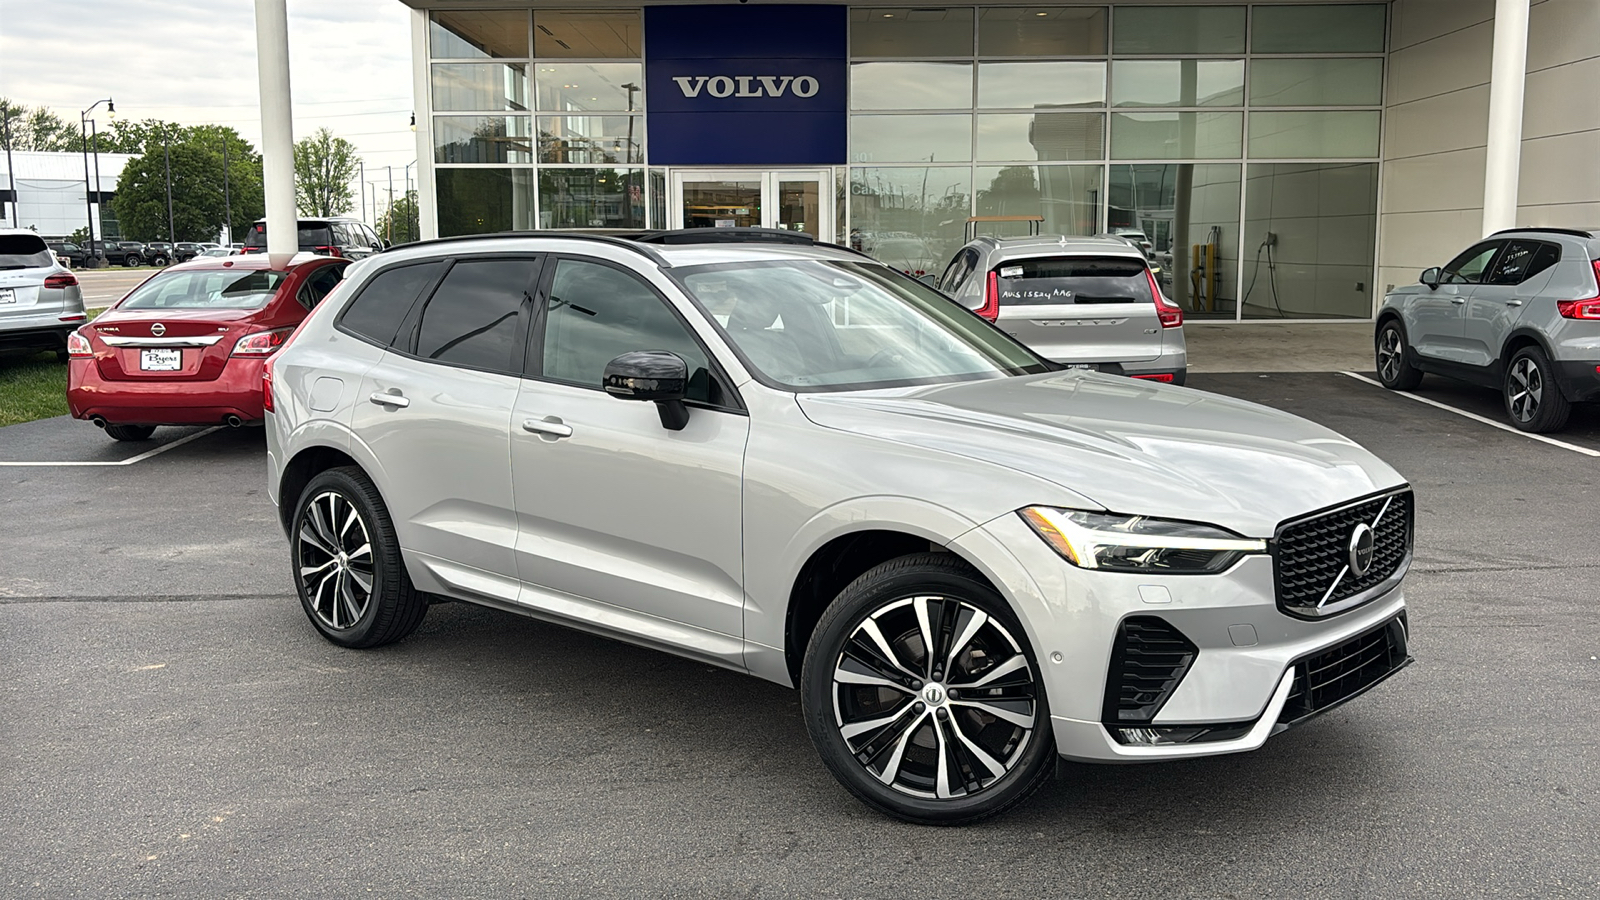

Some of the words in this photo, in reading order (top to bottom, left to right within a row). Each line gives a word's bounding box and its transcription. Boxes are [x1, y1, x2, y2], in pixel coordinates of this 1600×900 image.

[672, 75, 820, 98] VOLVO
[1041, 318, 1117, 327] VOLVO
[145, 352, 177, 364] Byers
